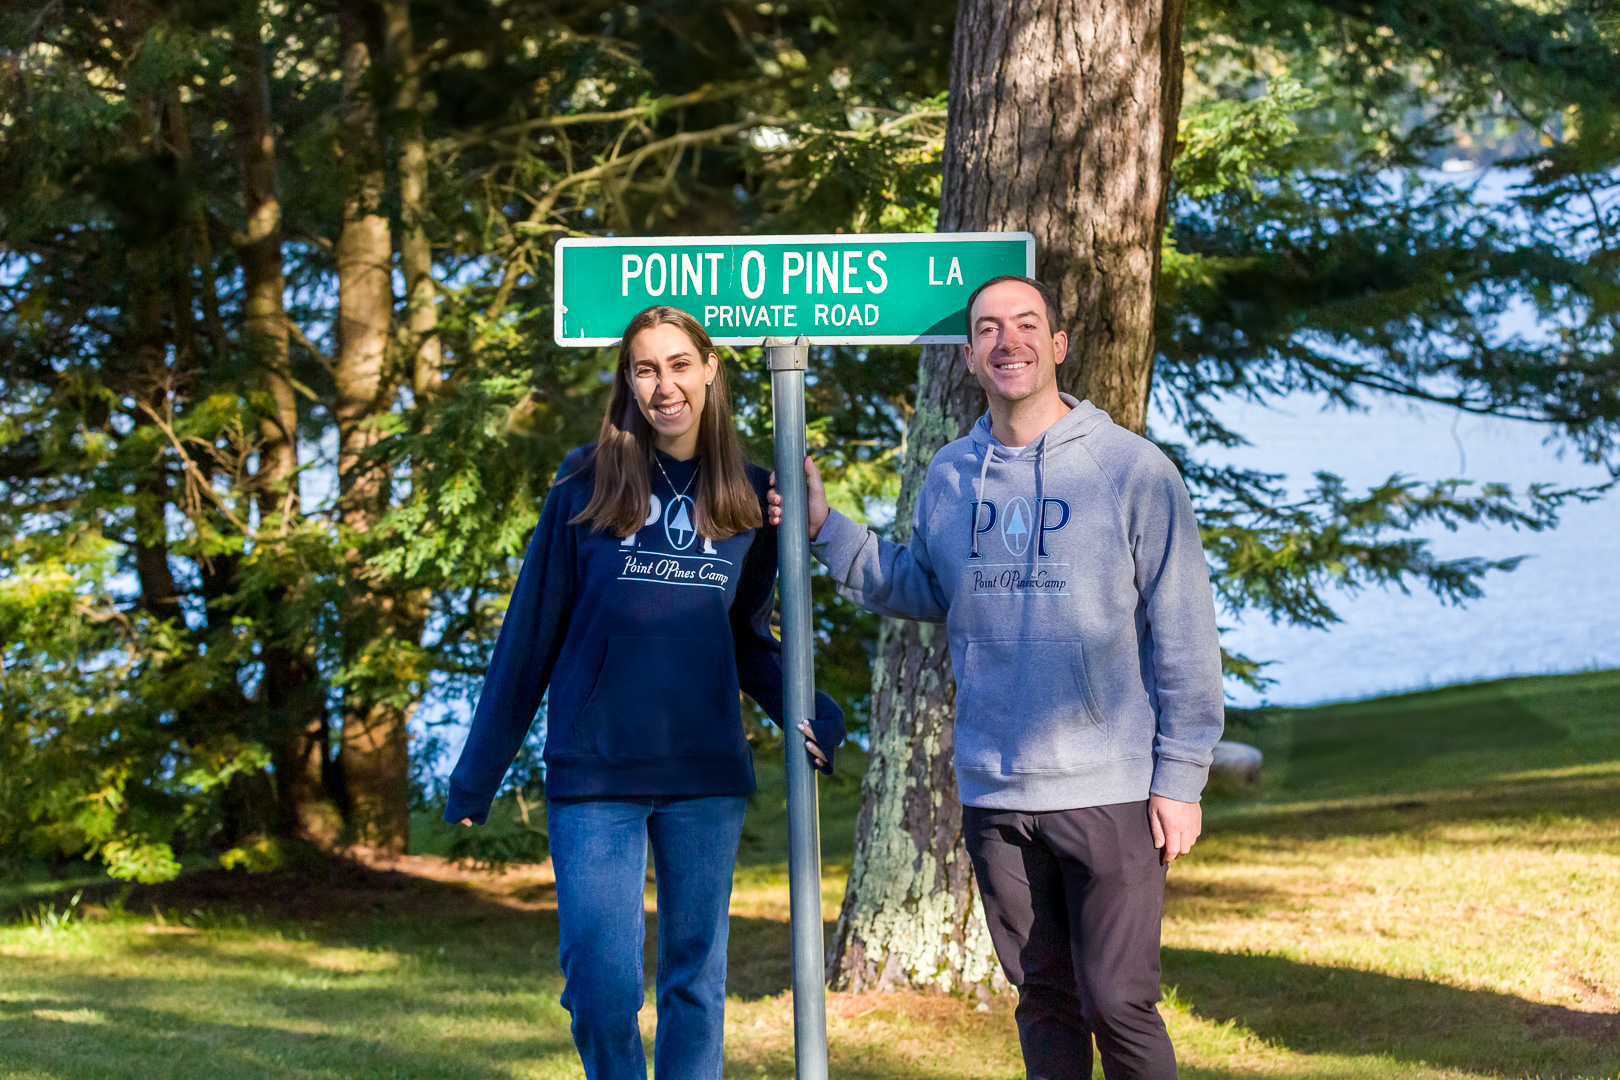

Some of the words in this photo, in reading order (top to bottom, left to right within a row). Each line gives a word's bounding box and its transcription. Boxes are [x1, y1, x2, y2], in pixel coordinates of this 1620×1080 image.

[621, 252, 725, 297] POINT
[740, 249, 766, 300] O
[782, 249, 889, 295] PINES
[928, 256, 964, 286] LA
[704, 304, 798, 328] PRIVATE
[814, 303, 880, 327] ROAD
[622, 555, 654, 575] Point
[698, 563, 729, 585] Camp
[973, 570, 997, 591] Point
[1035, 570, 1067, 592] Camp
